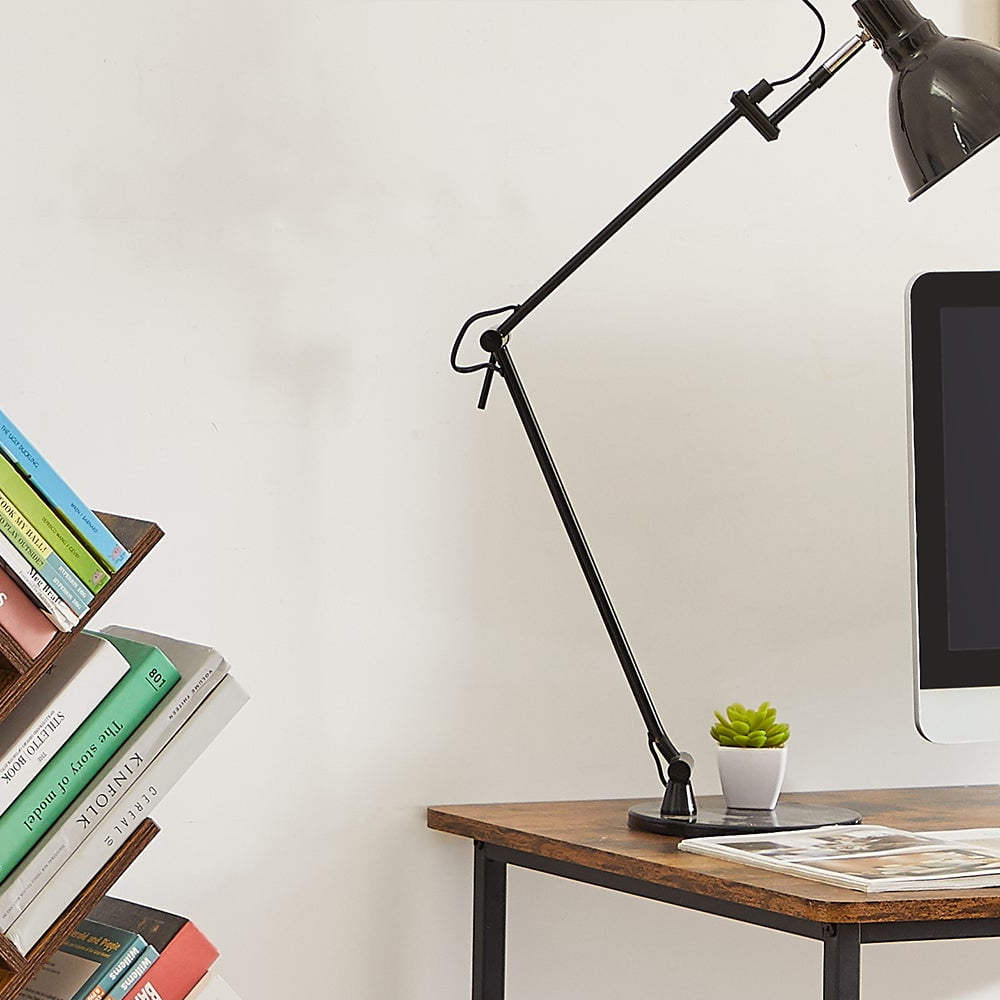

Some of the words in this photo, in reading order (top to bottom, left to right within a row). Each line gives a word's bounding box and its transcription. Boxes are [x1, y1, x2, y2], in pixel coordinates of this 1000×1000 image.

[0, 424, 10, 435] THE
[7, 433, 20, 447] UGLY
[17, 444, 39, 469] DUCKLING
[2, 521, 19, 539] PLAY
[16, 537, 45, 568] OUTSIDE?
[14, 516, 27, 530] MY
[24, 528, 47, 553] BALL!
[147, 666, 166, 688] 801
[190, 668, 213, 694] VOLUME
[24, 709, 66, 757] STILETTO
[97, 717, 124, 748] The
[0, 754, 27, 785] BOOK
[36, 751, 47, 763] THE
[67, 740, 101, 778] story
[55, 774, 73, 795] of
[74, 750, 144, 831] KINFOLK
[21, 789, 60, 833] model
[112, 784, 158, 836] CEREAL
[107, 944, 140, 982] Willems
[119, 955, 152, 992] Willems
